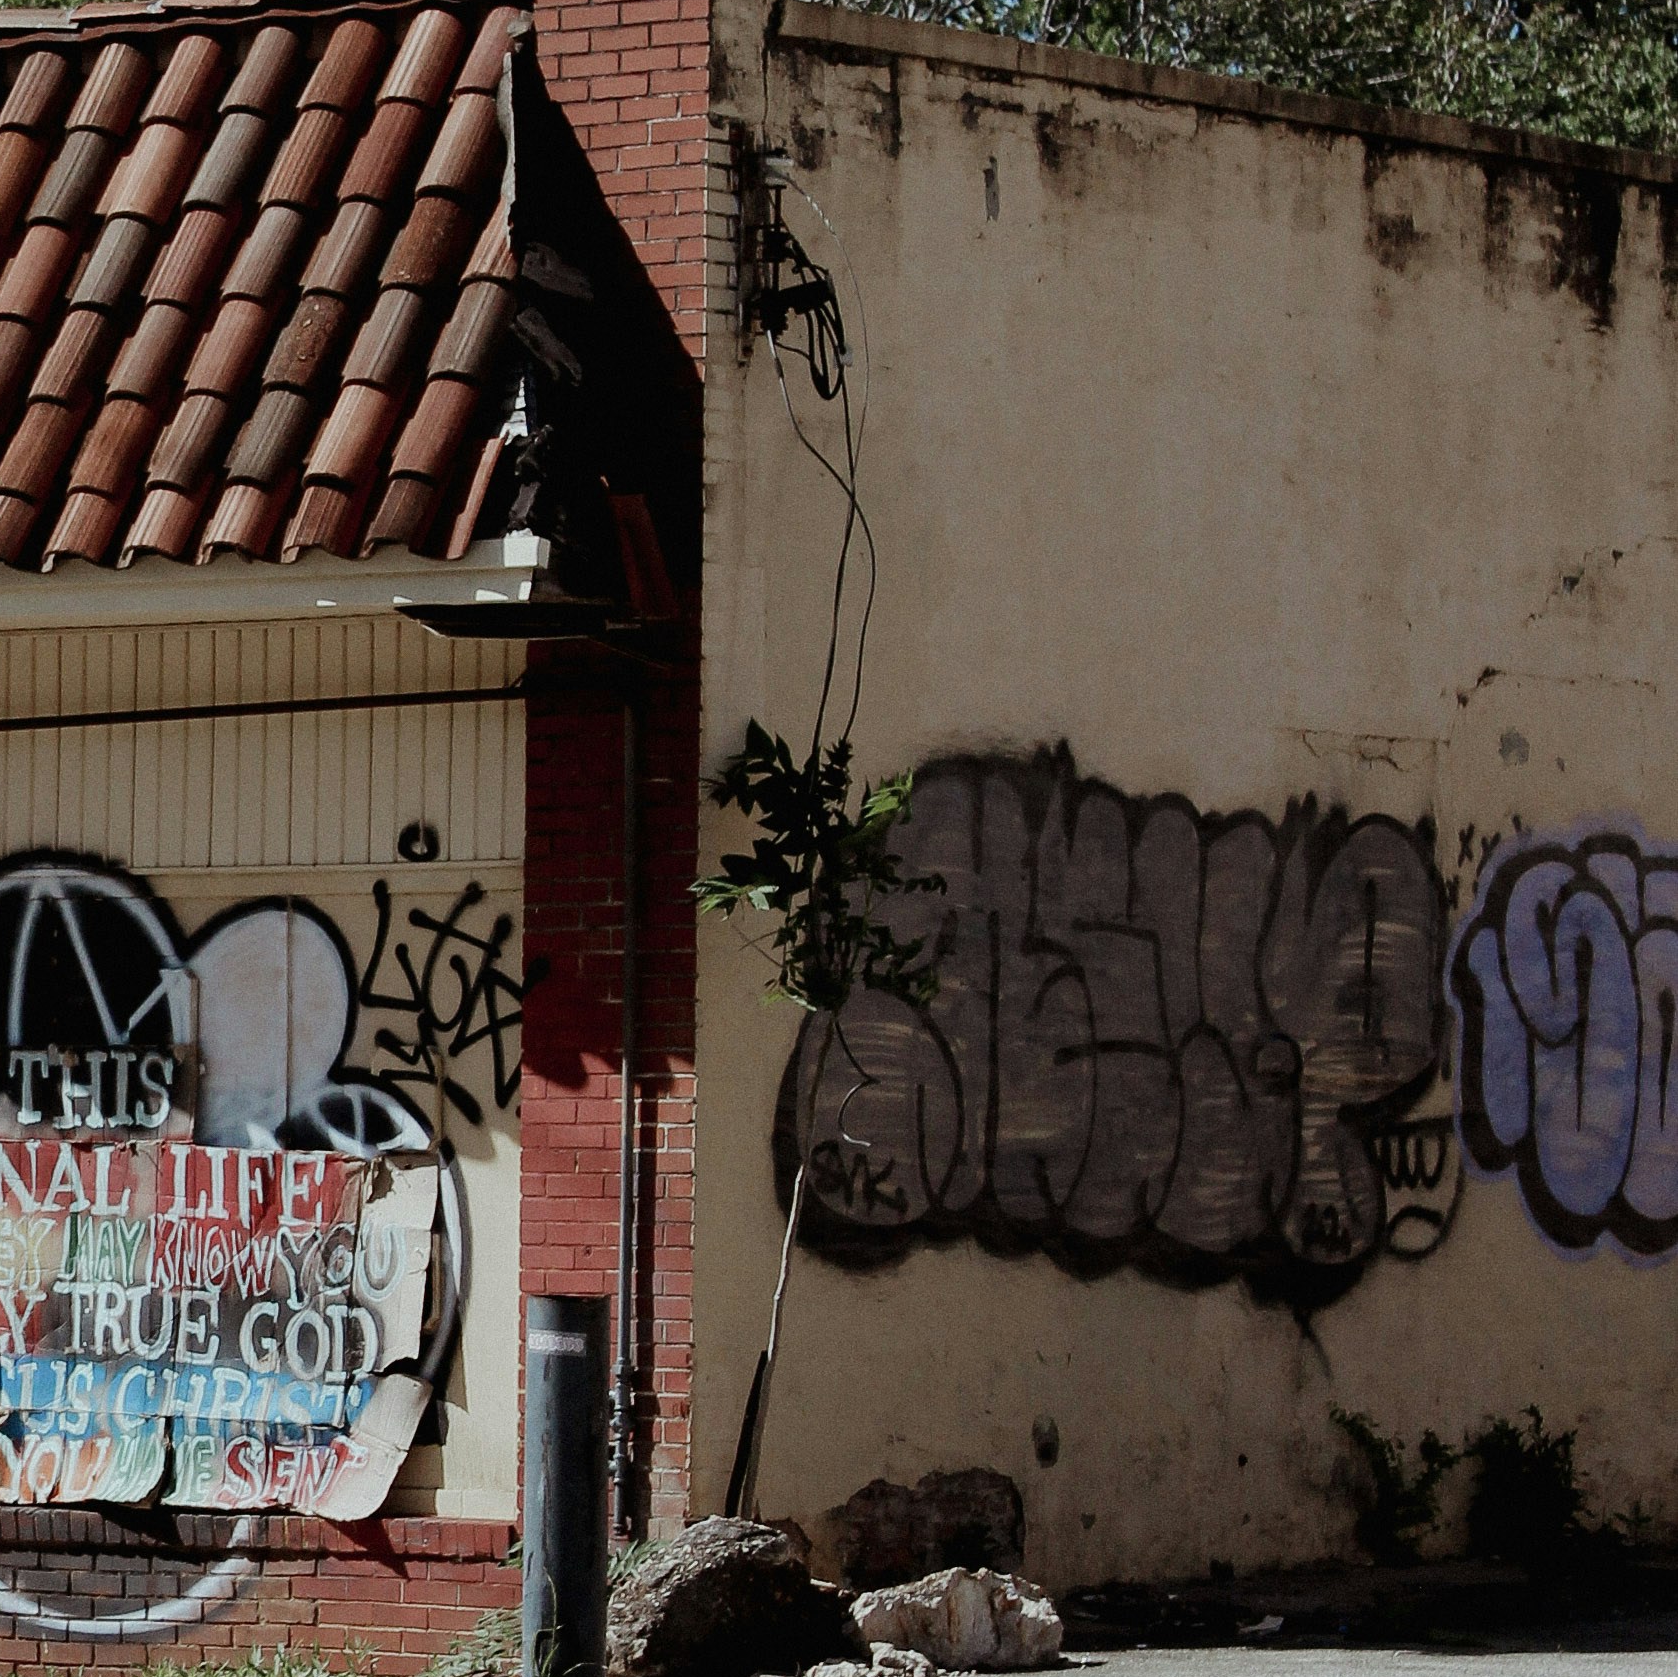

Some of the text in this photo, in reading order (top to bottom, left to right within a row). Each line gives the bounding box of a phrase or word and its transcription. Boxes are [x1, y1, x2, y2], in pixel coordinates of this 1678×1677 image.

[9, 1048, 174, 1129] THIS
[157, 1142, 331, 1225] LIFE
[57, 1212, 145, 1288] MAY
[147, 1212, 277, 1300] KNOW
[275, 1221, 405, 1311] YOU
[52, 1280, 220, 1364] TRUE
[239, 1301, 380, 1385] GOD
[112, 1364, 360, 1447] CHRIST
[214, 1433, 370, 1510] SENT
